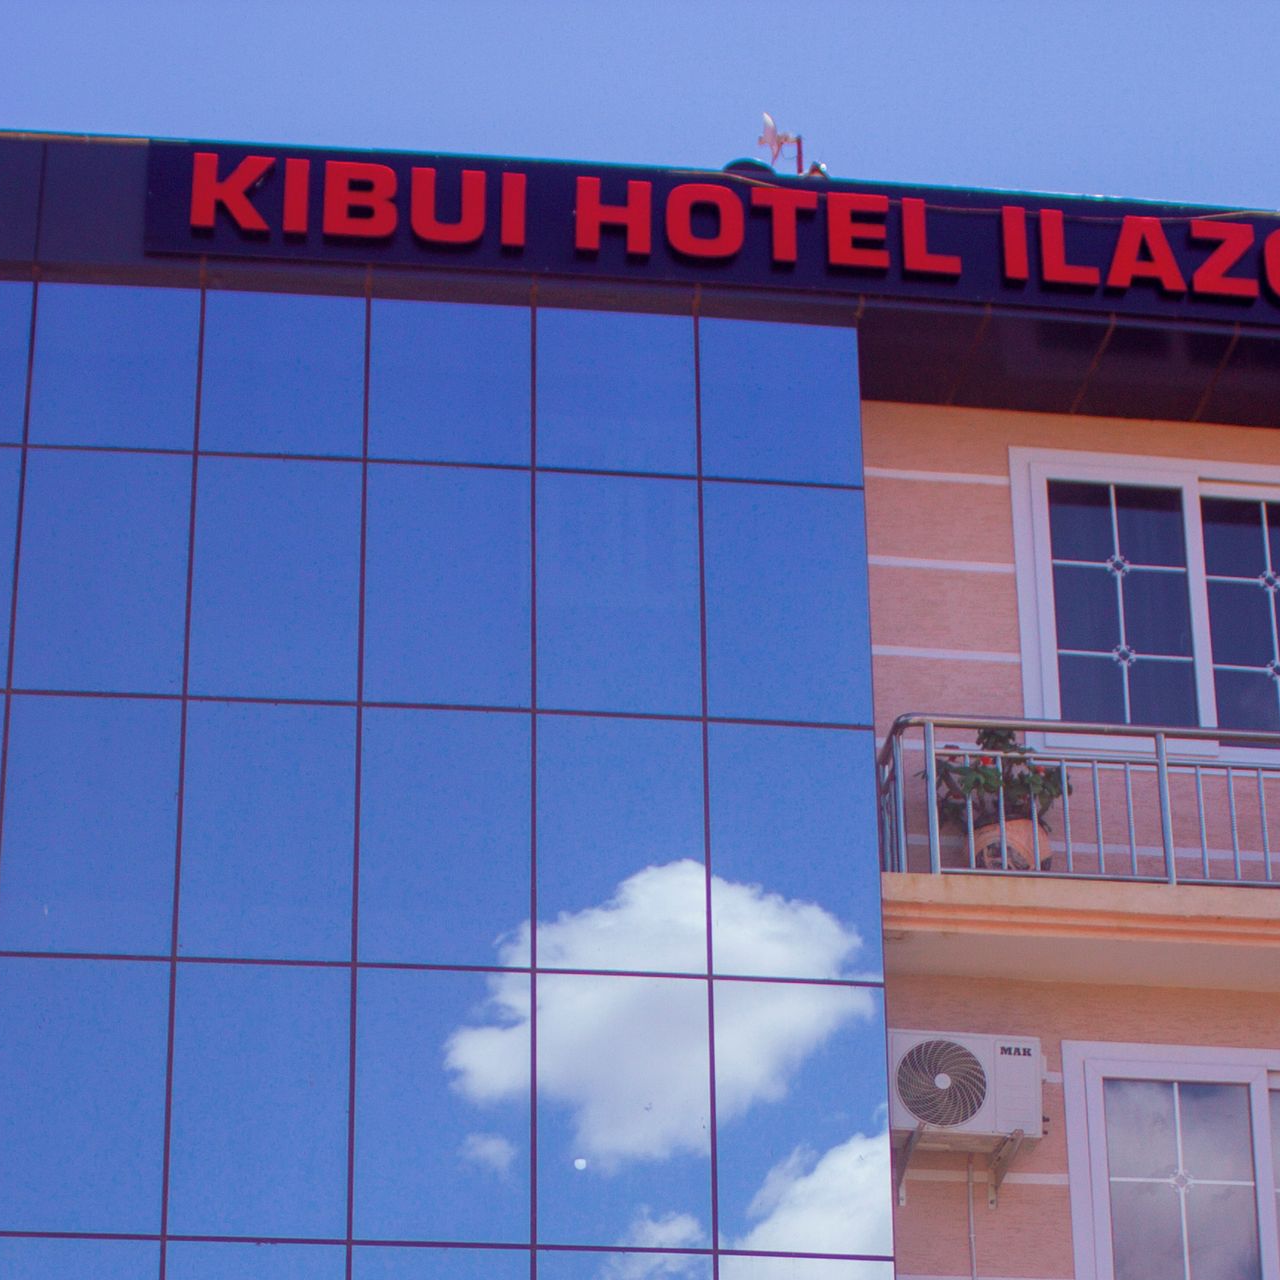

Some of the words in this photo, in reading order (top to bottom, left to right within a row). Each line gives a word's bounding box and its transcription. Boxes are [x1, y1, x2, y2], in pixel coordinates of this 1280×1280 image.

[190, 152, 526, 245] KIBUI
[575, 175, 961, 274] HOTEL
[1000, 1046, 1032, 1057] MAK
